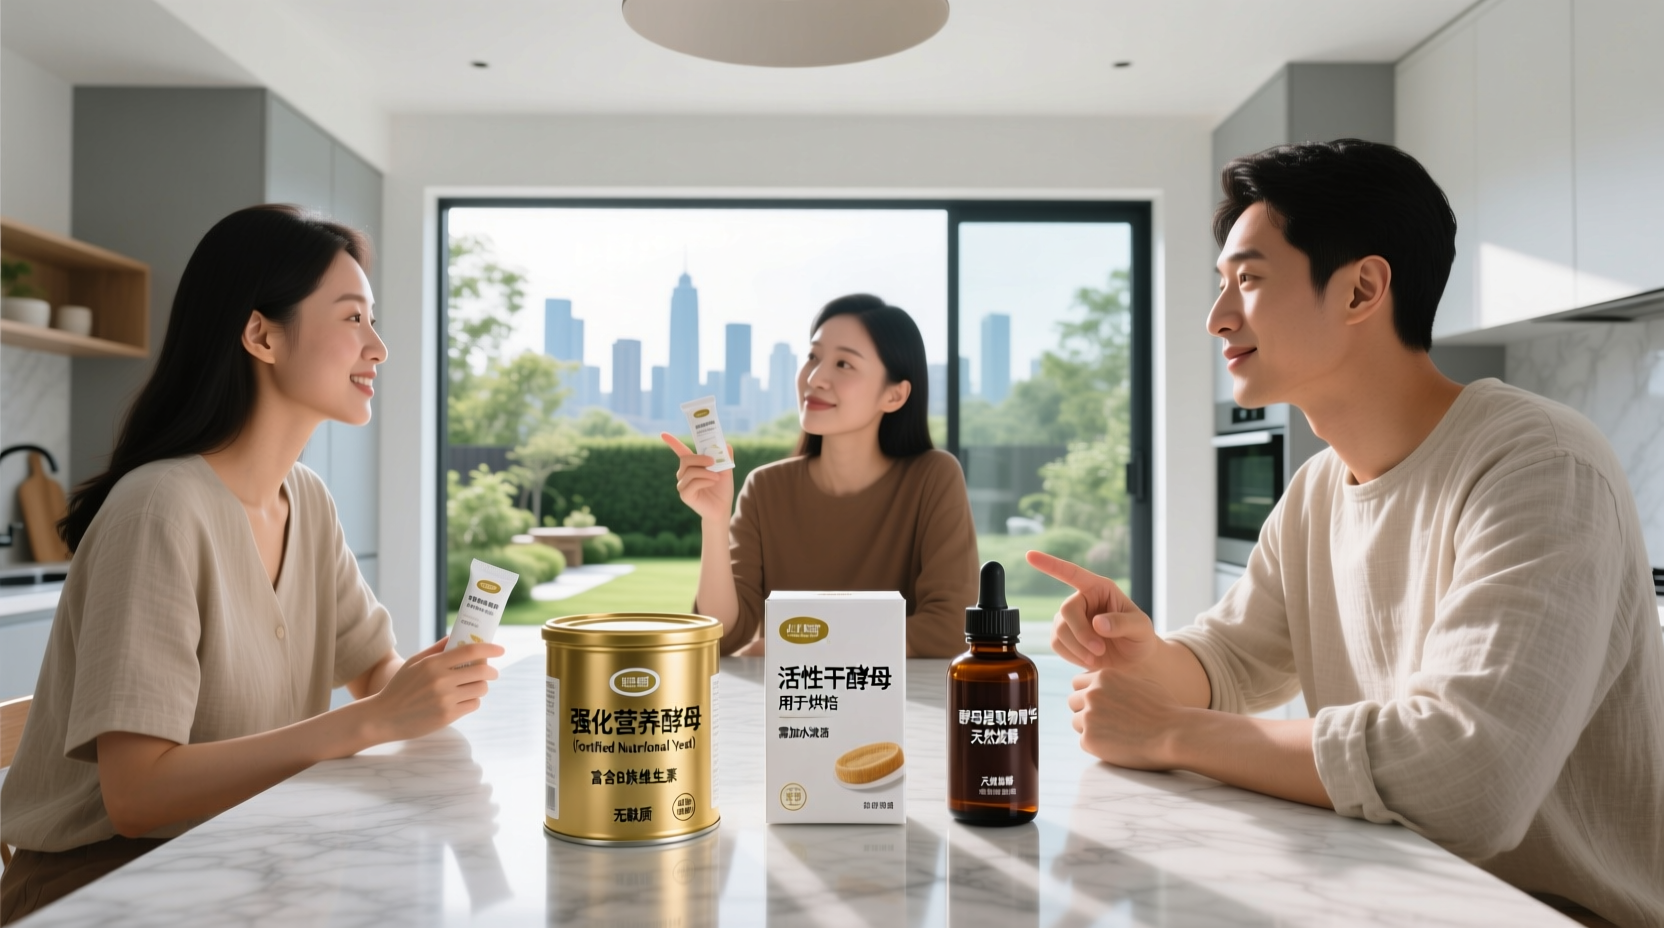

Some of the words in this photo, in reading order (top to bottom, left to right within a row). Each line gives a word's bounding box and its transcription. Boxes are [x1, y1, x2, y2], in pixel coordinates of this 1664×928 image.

[778, 664, 892, 690] 活性干酵母
[571, 705, 702, 735] 强化营养酵母
